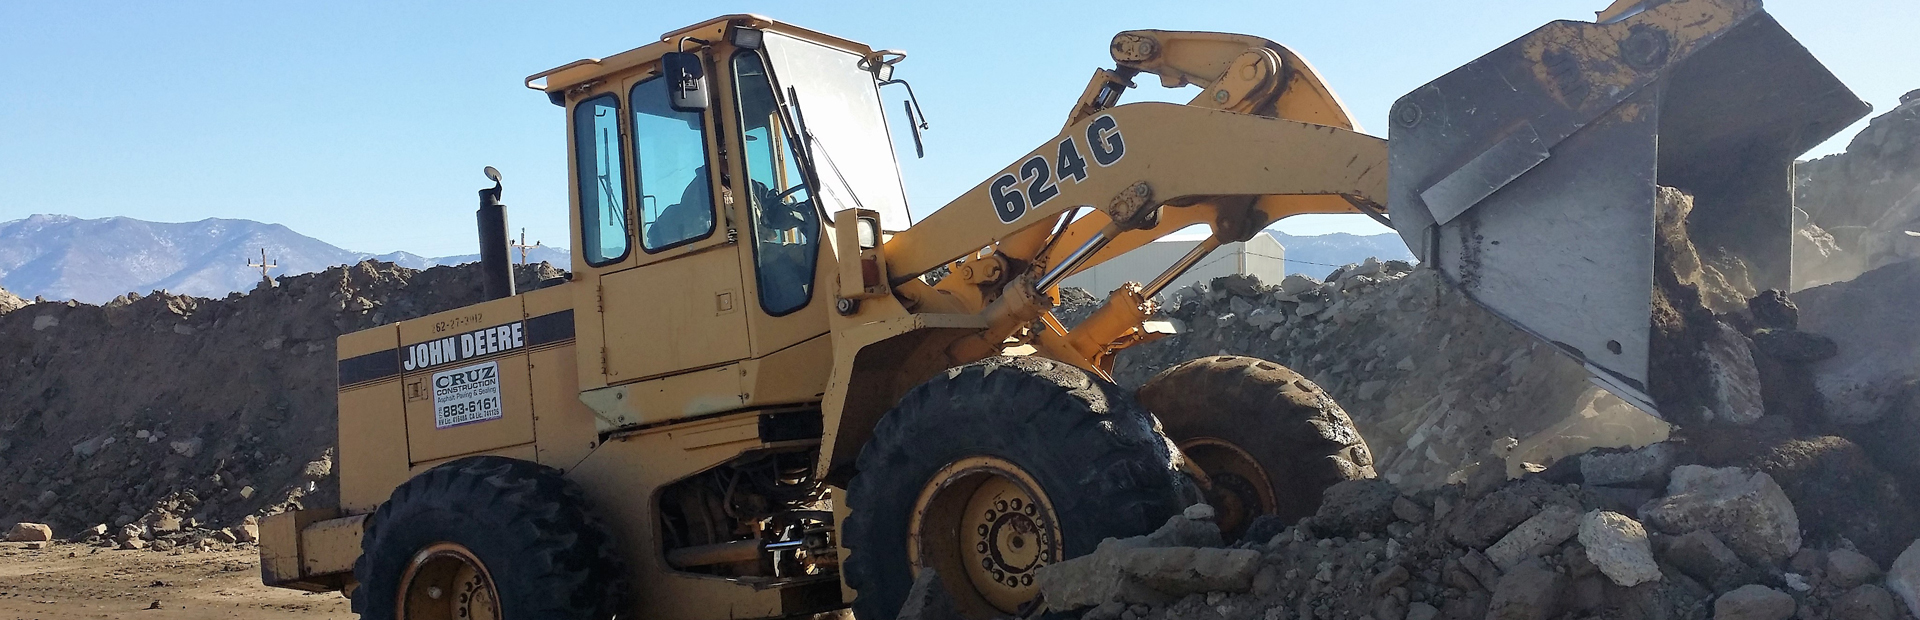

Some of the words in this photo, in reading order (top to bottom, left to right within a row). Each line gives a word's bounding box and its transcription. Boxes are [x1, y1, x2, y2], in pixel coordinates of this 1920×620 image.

[989, 135, 1089, 225] 624
[1086, 114, 1125, 168] G
[403, 337, 456, 371] JOHN
[461, 322, 524, 359] DEERE
[435, 365, 496, 389] CRUZ
[436, 378, 496, 396] CONSTRUCTION
[437, 395, 456, 404] Asphalt
[456, 391, 473, 400] Paving
[478, 386, 497, 396] Sealing
[443, 396, 498, 418] 883-6161
